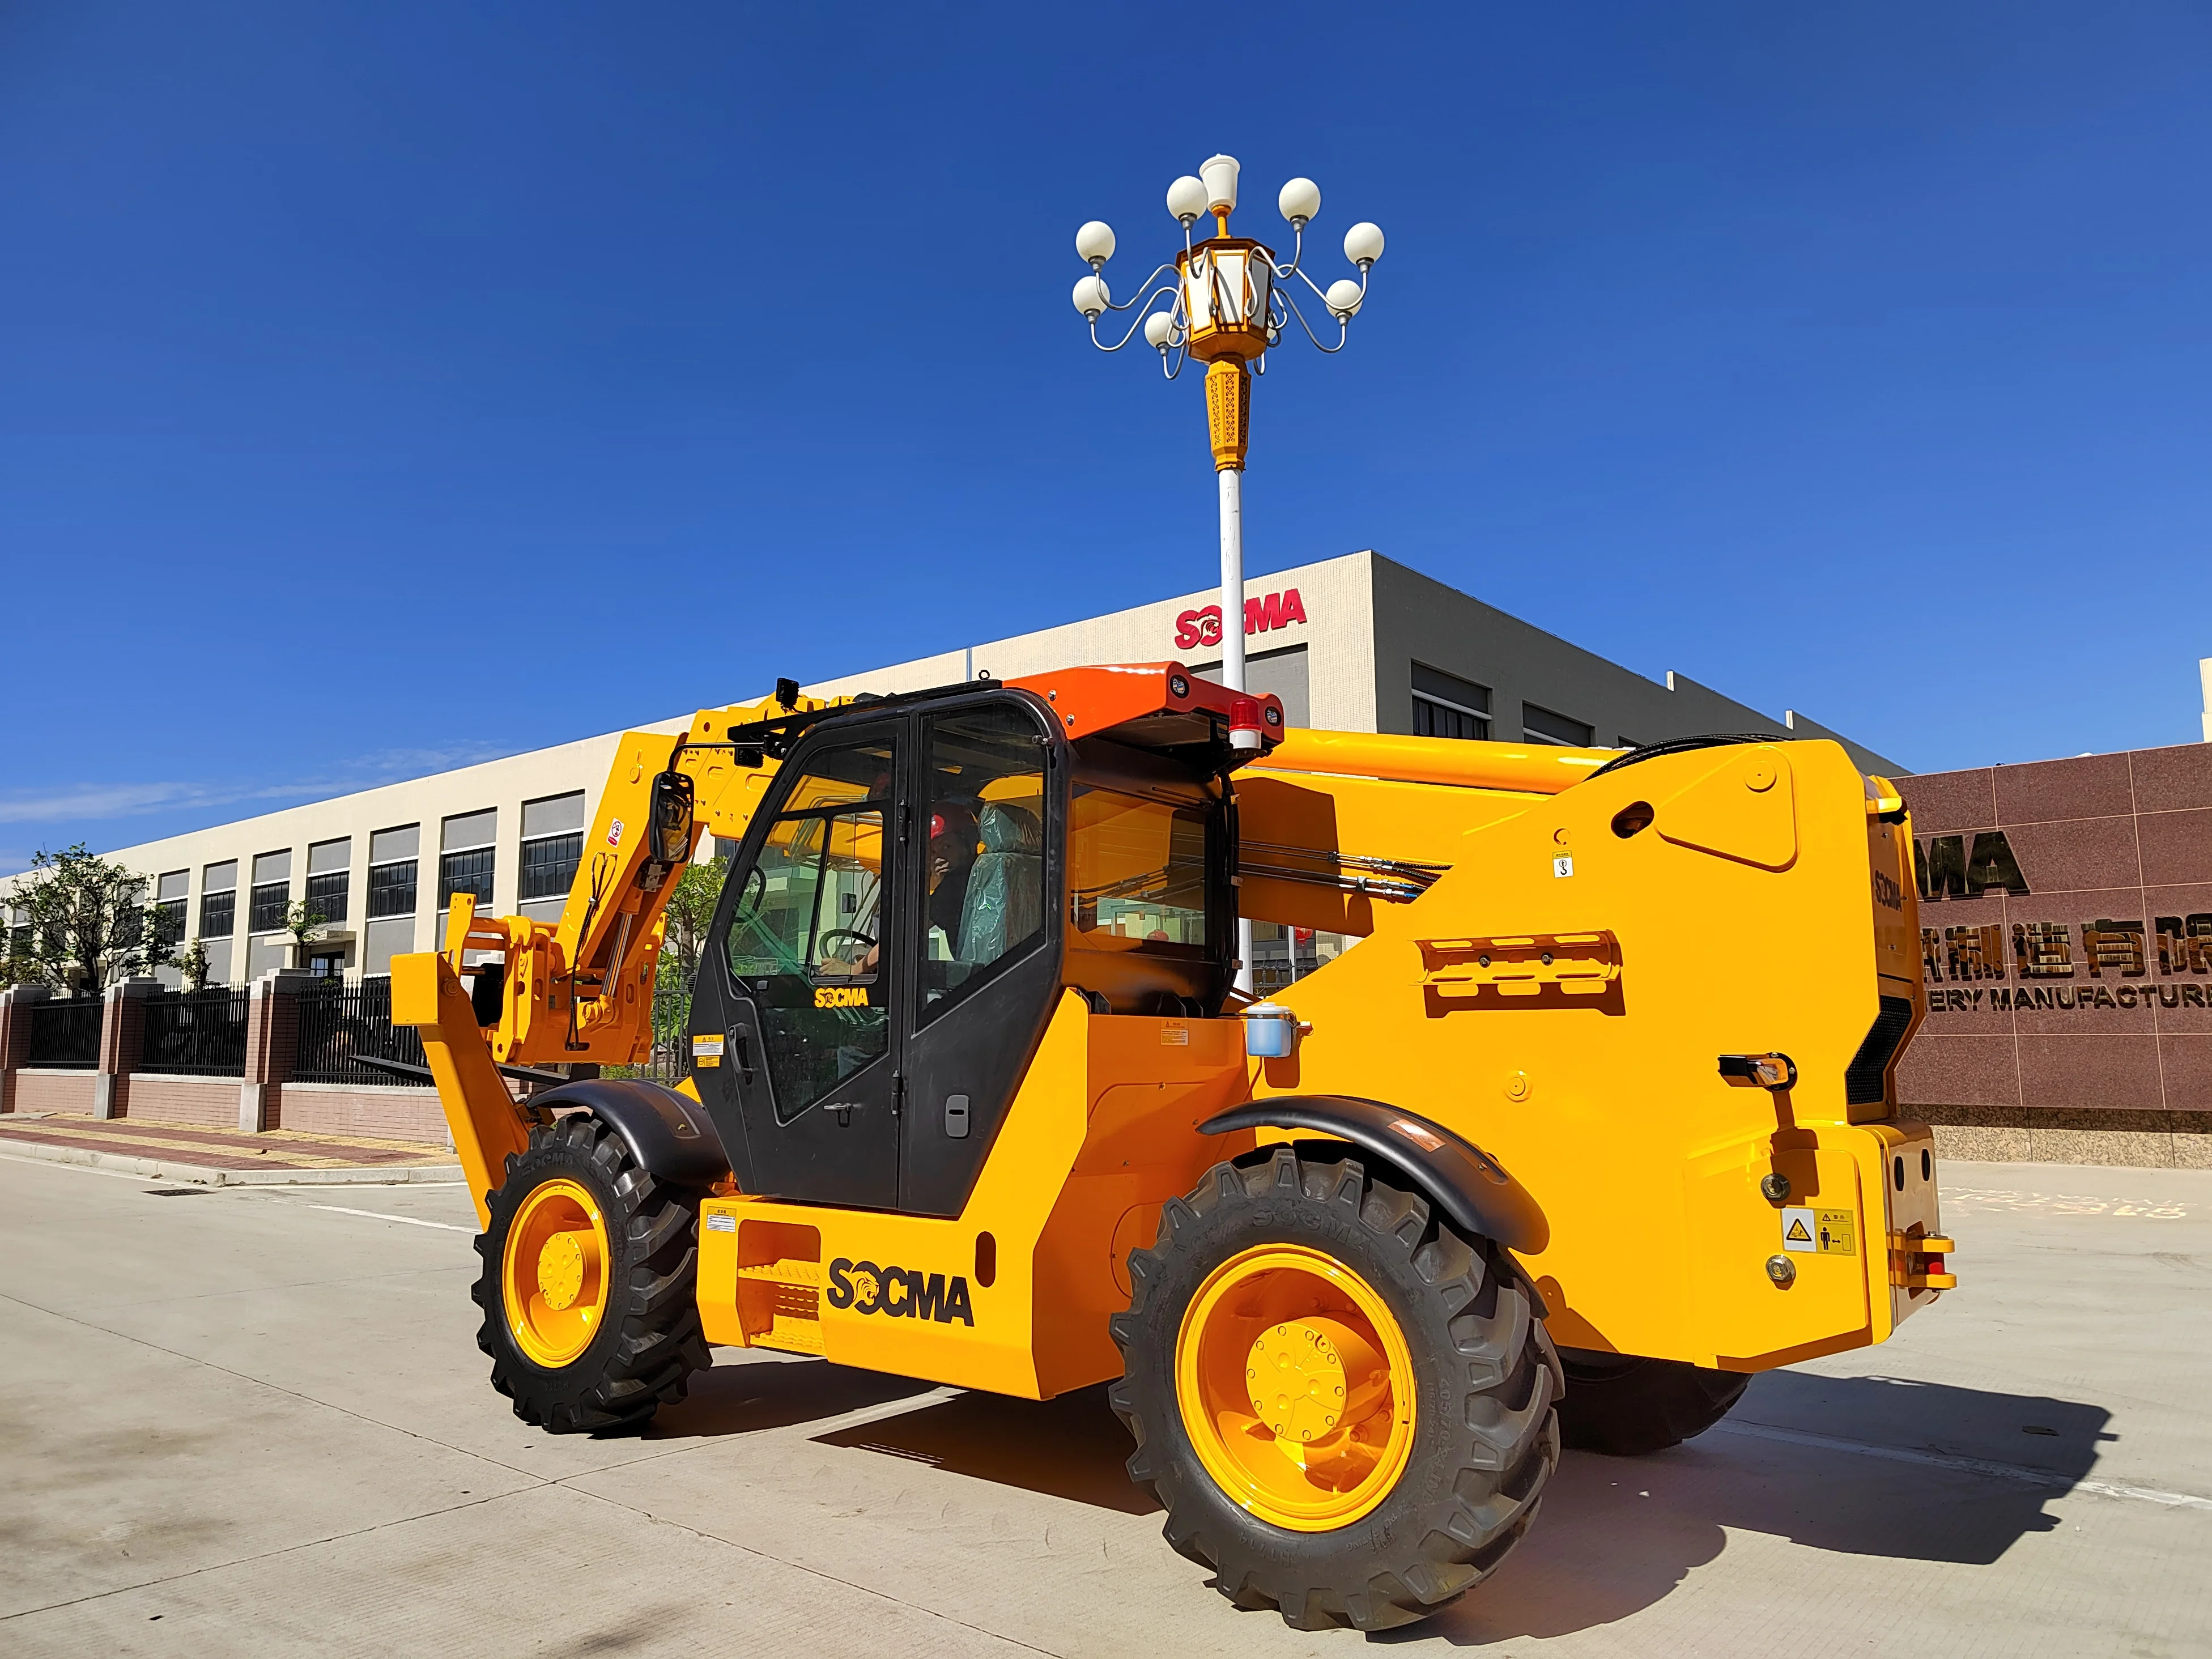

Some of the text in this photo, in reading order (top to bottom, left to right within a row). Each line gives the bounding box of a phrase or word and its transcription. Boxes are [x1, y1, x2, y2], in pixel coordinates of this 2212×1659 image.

[1175, 588, 1307, 649] SOMA
[814, 988, 869, 1008] SOCMA
[1252, 1205, 1371, 1260] SOCMA
[827, 1257, 975, 1327] SOCMA
